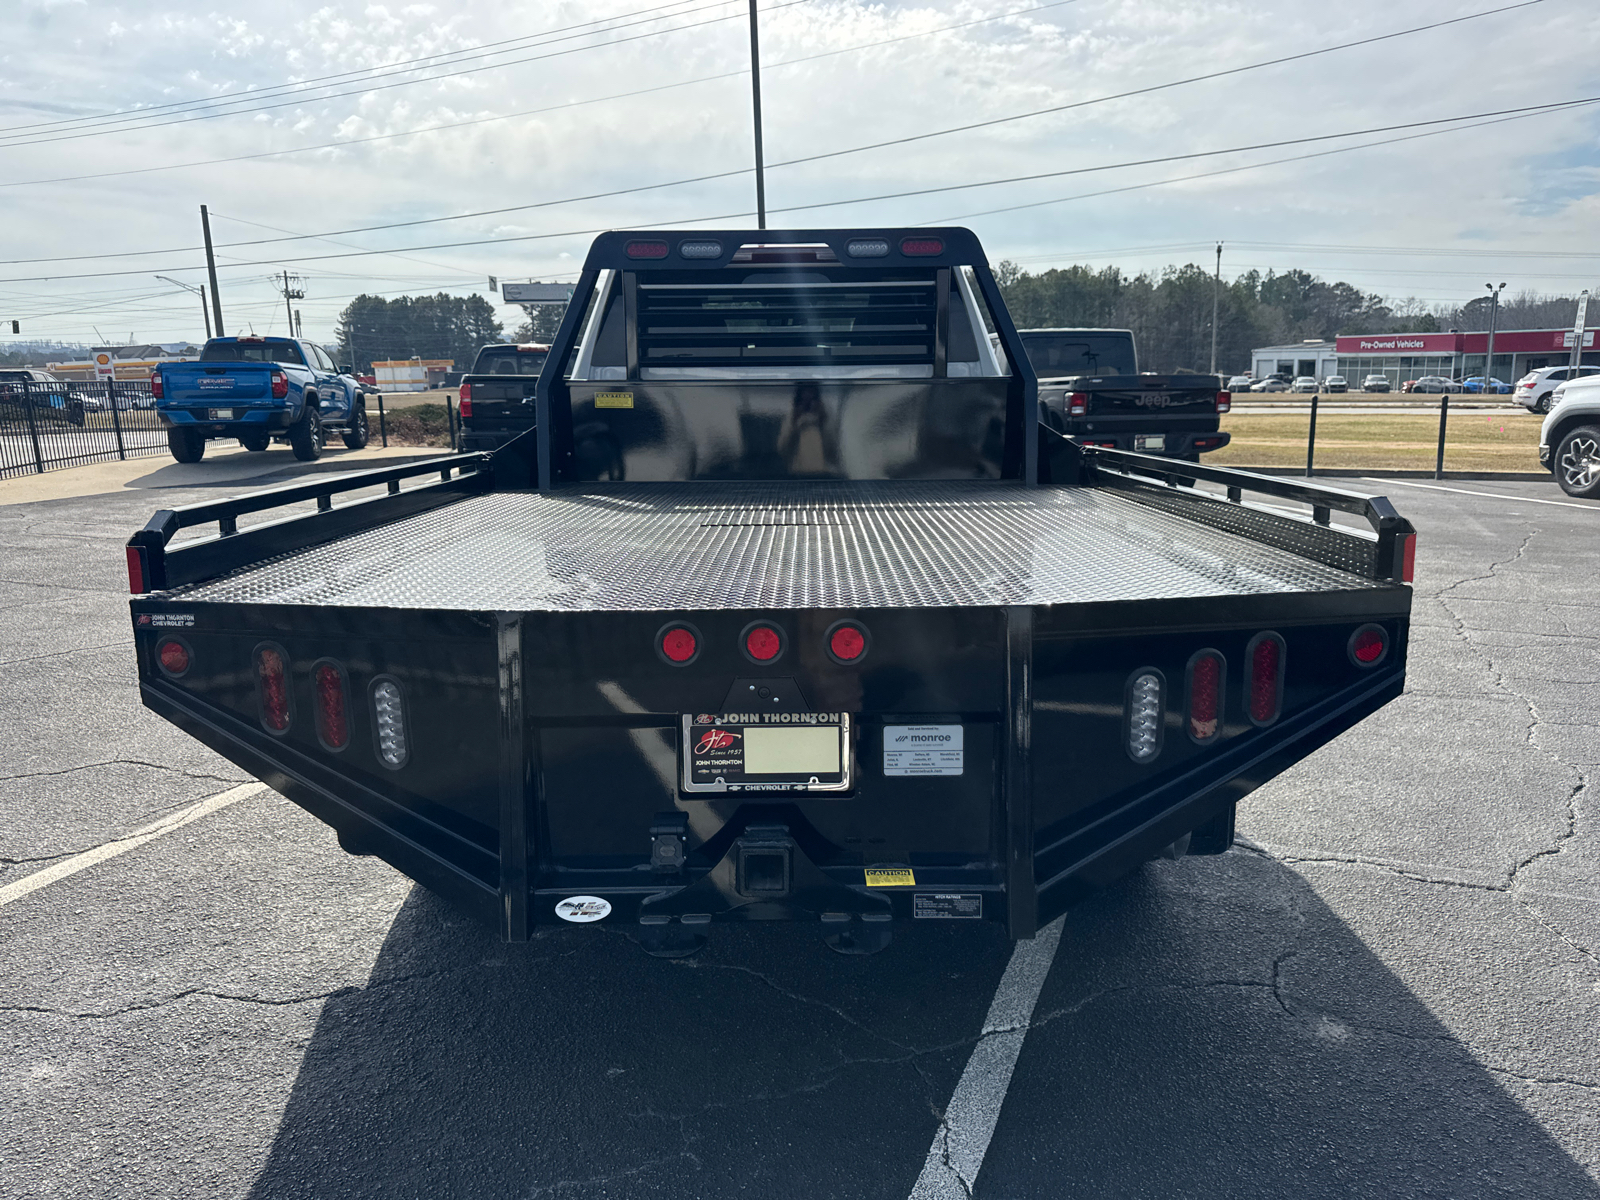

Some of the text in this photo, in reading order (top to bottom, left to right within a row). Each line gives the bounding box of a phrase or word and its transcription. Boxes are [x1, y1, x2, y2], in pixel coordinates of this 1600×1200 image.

[1360, 340, 1424, 349] Pre-Owned Vehicles
[1135, 393, 1171, 408] Jeep
[722, 713, 839, 723] JOHN THORNTON
